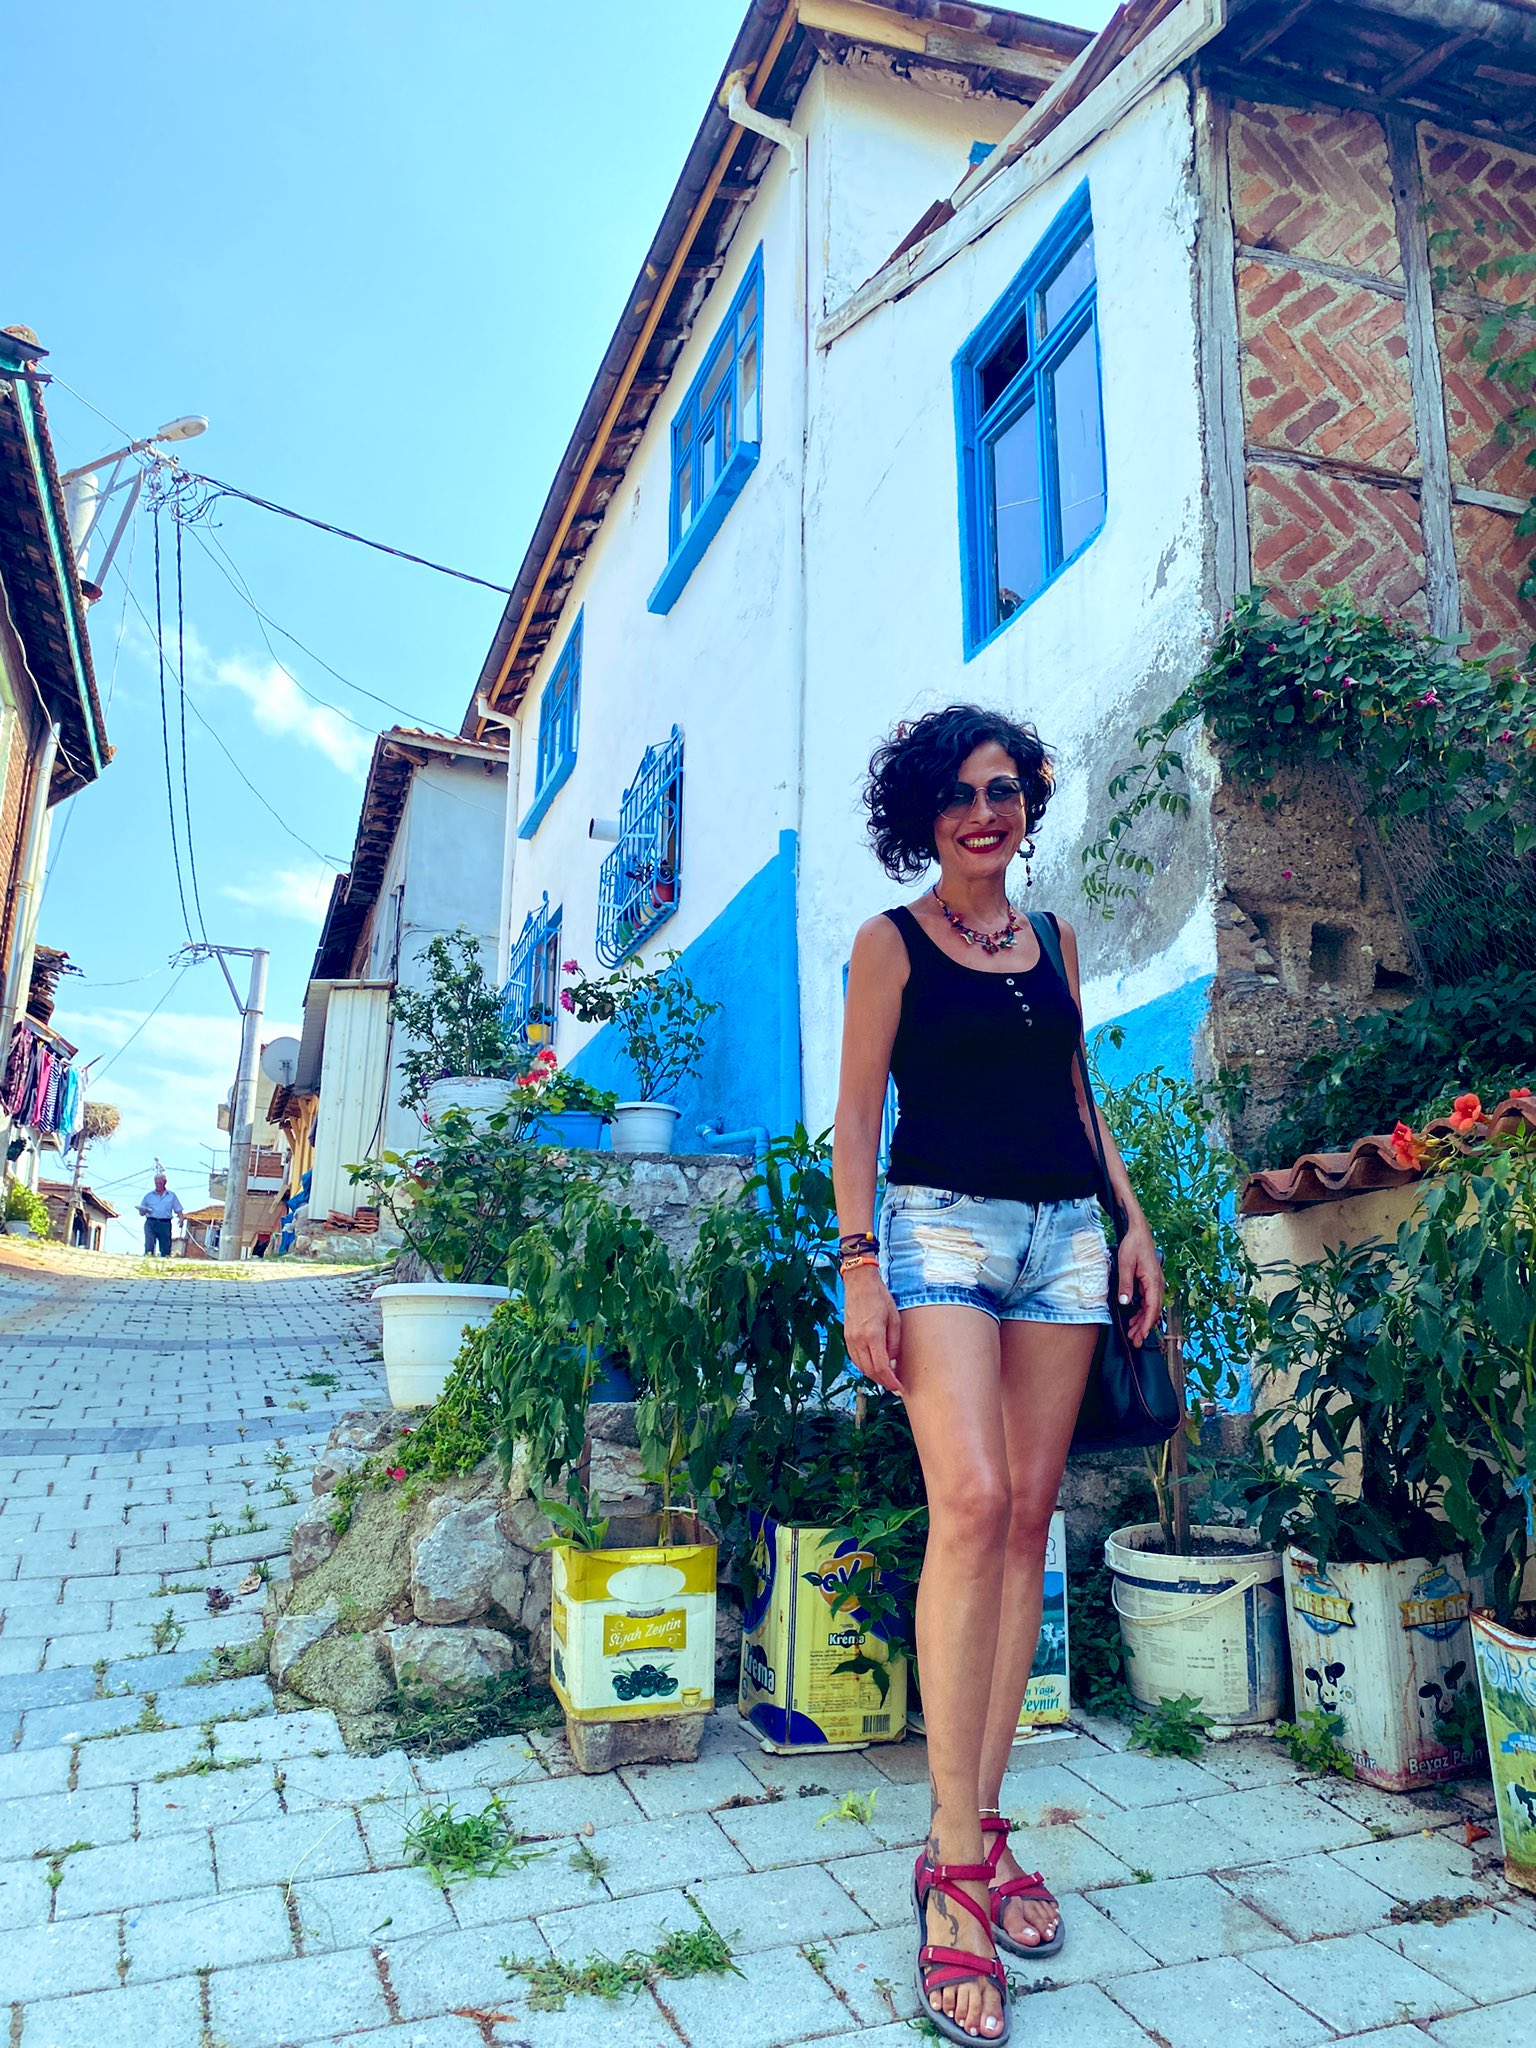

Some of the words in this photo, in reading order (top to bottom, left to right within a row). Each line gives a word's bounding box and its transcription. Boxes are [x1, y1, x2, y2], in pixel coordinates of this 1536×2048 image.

[608, 1626, 642, 1648] Siyah
[645, 1618, 682, 1639] Zeytin
[1408, 1756, 1449, 1774] Beyaz
